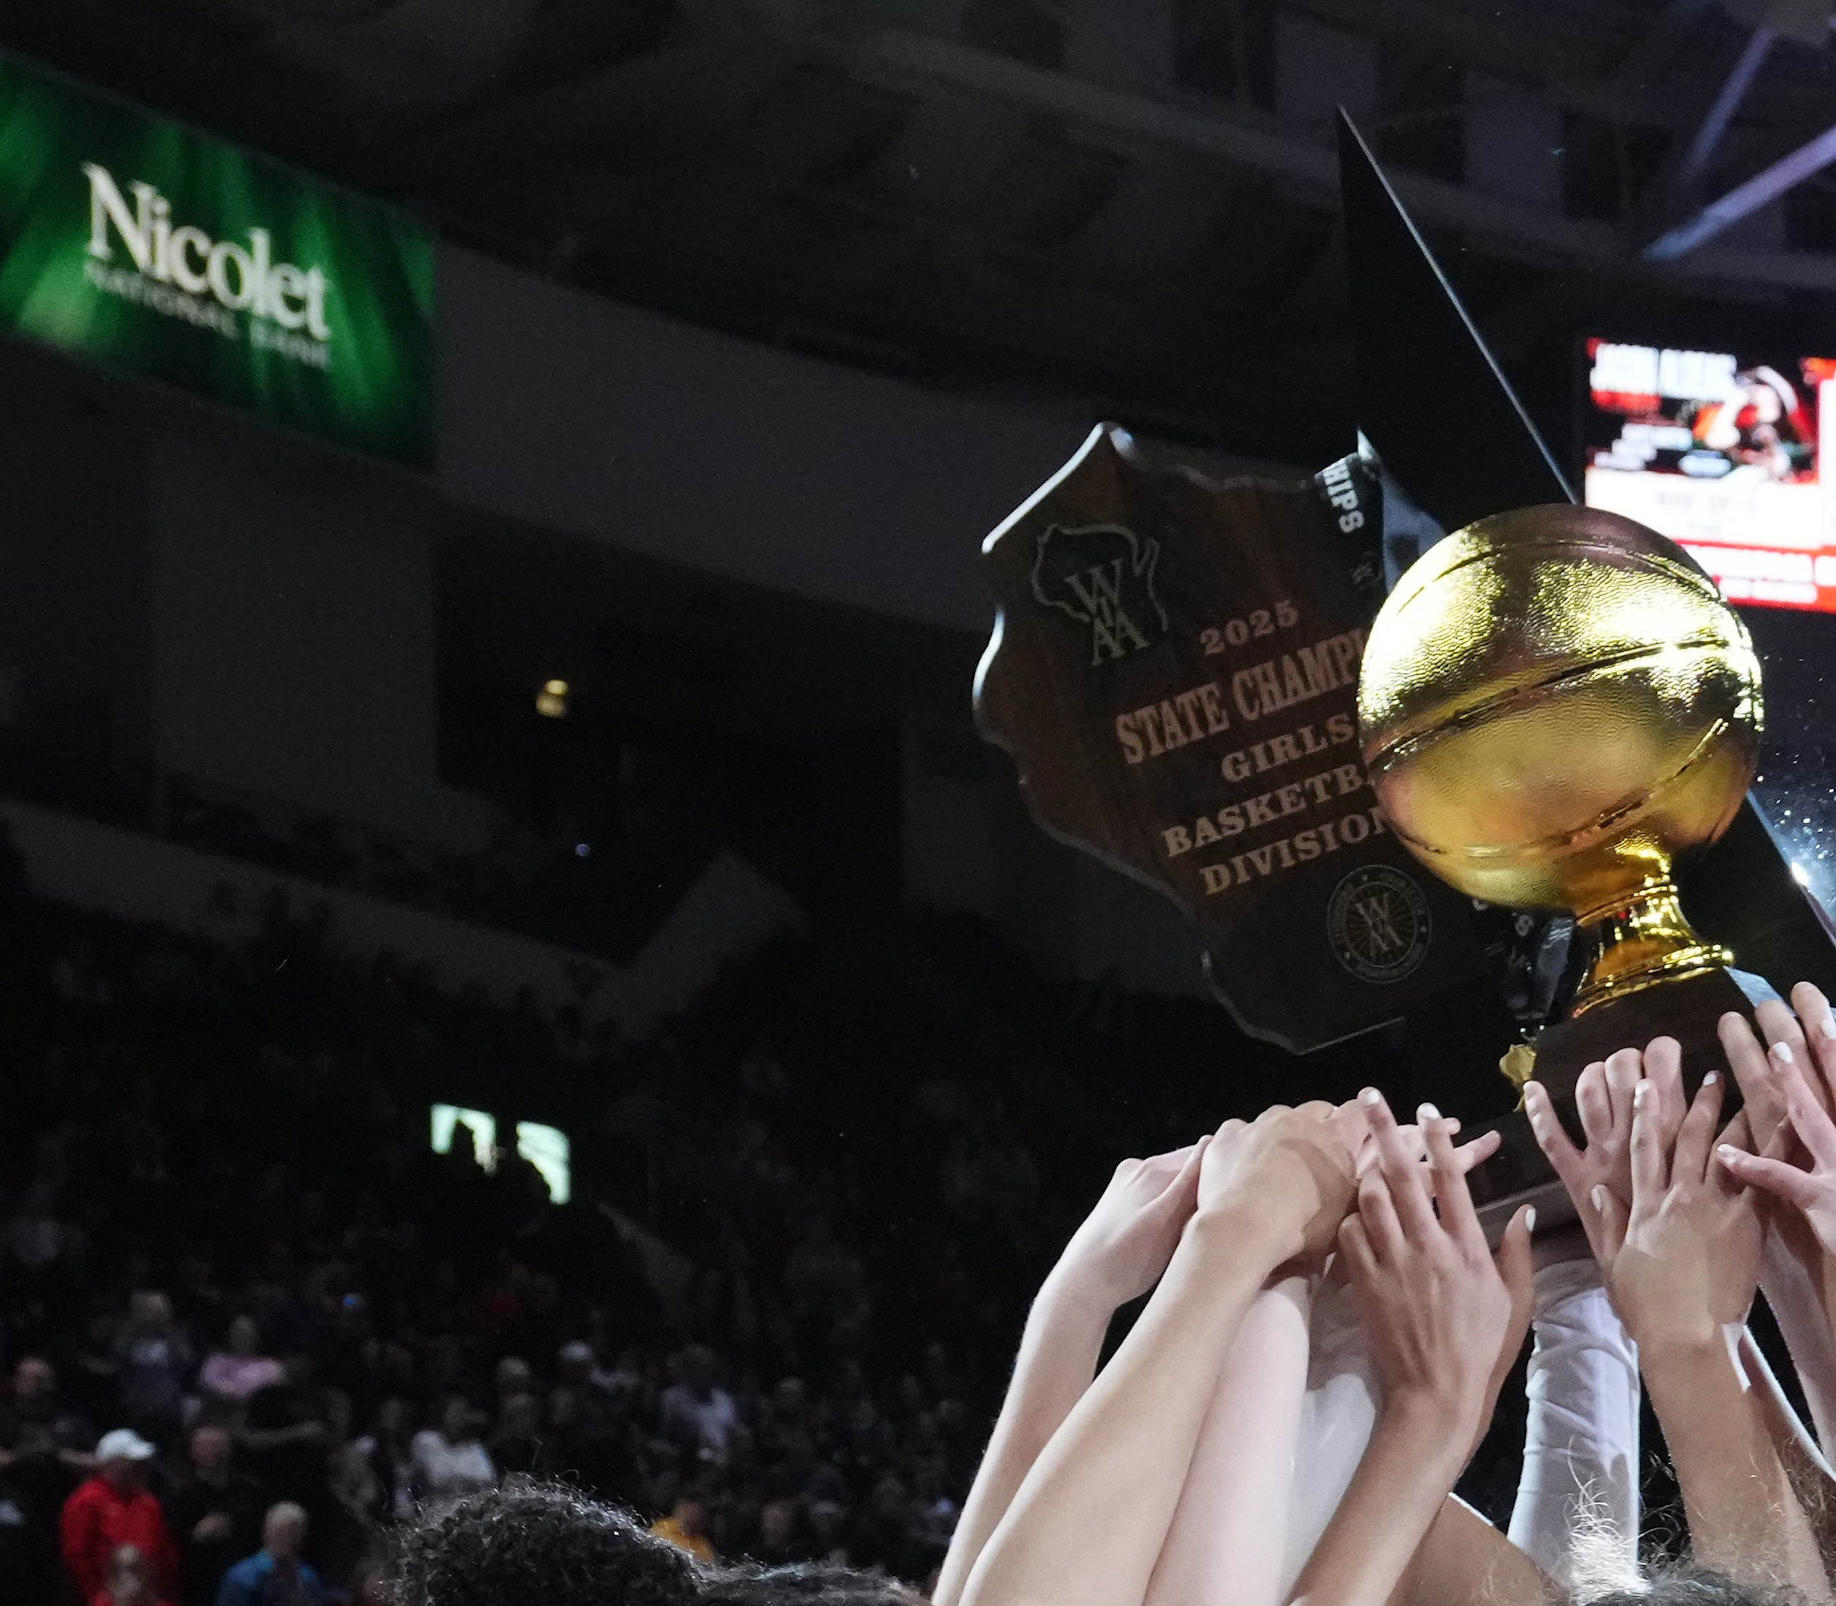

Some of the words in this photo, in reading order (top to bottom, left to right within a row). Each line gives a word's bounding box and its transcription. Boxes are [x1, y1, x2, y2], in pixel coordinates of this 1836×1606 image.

[83, 160, 331, 341] Nicolet
[1201, 602, 1299, 655] 2025
[1115, 685, 1230, 765] STATE
[1221, 713, 1354, 783] GIRLS
